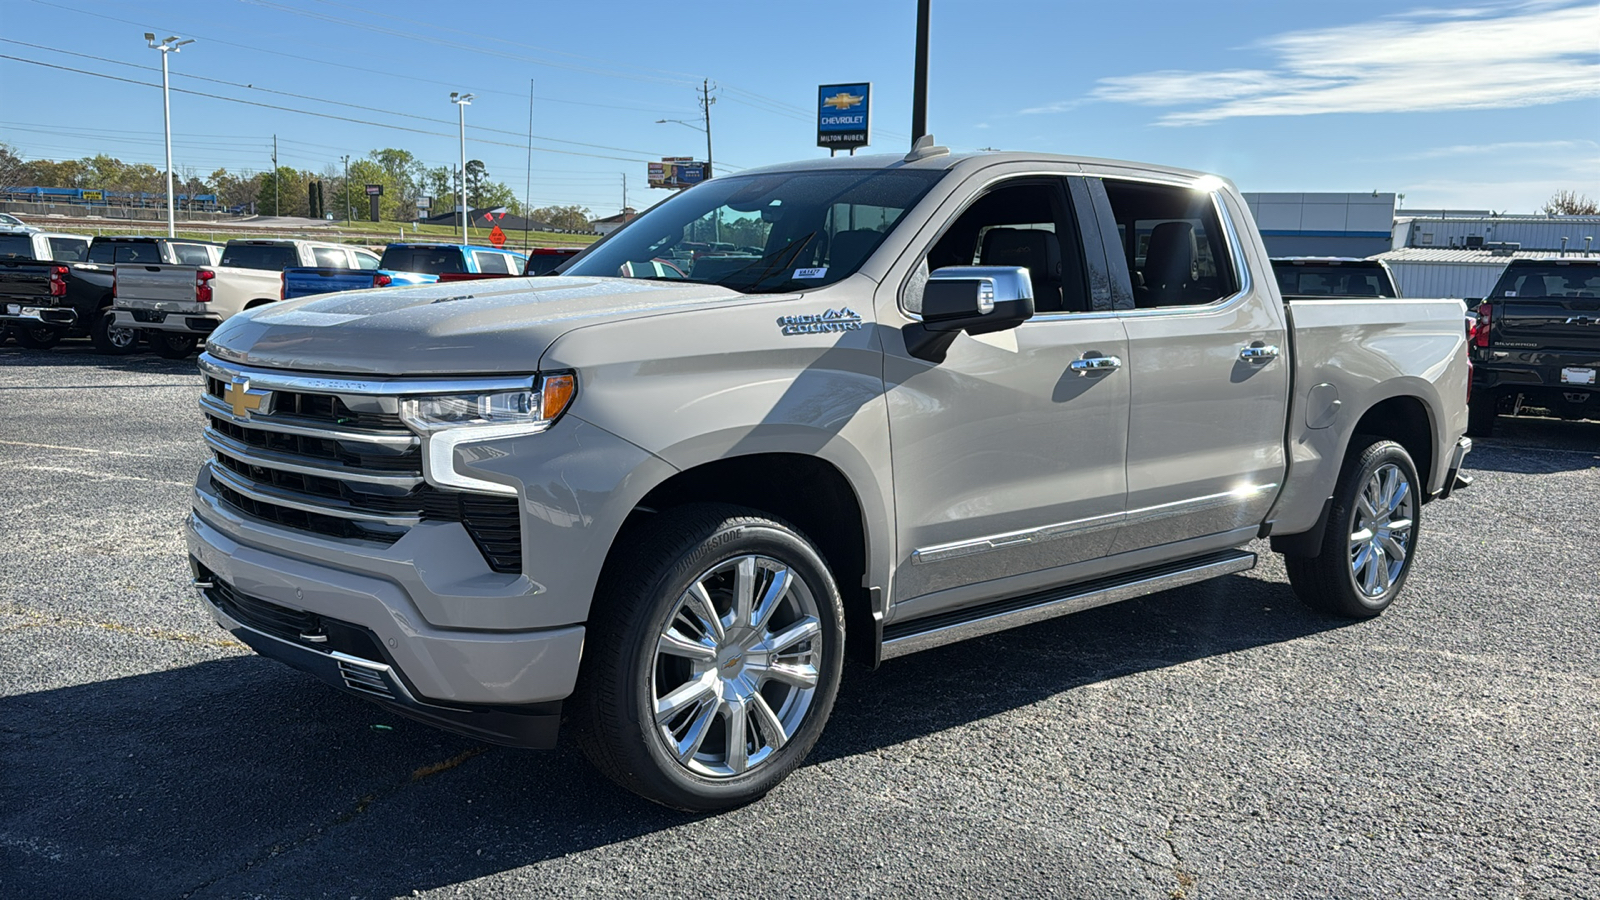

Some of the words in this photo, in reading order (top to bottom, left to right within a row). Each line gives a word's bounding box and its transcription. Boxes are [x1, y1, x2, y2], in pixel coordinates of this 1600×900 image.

[821, 115, 864, 125] CHEVROLET
[820, 134, 842, 142] MILTON
[843, 133, 865, 141] RUBEN
[777, 314, 822, 326] HIGH
[782, 321, 862, 336] COUNTRY
[674, 528, 742, 574] BRIDGESTONE
